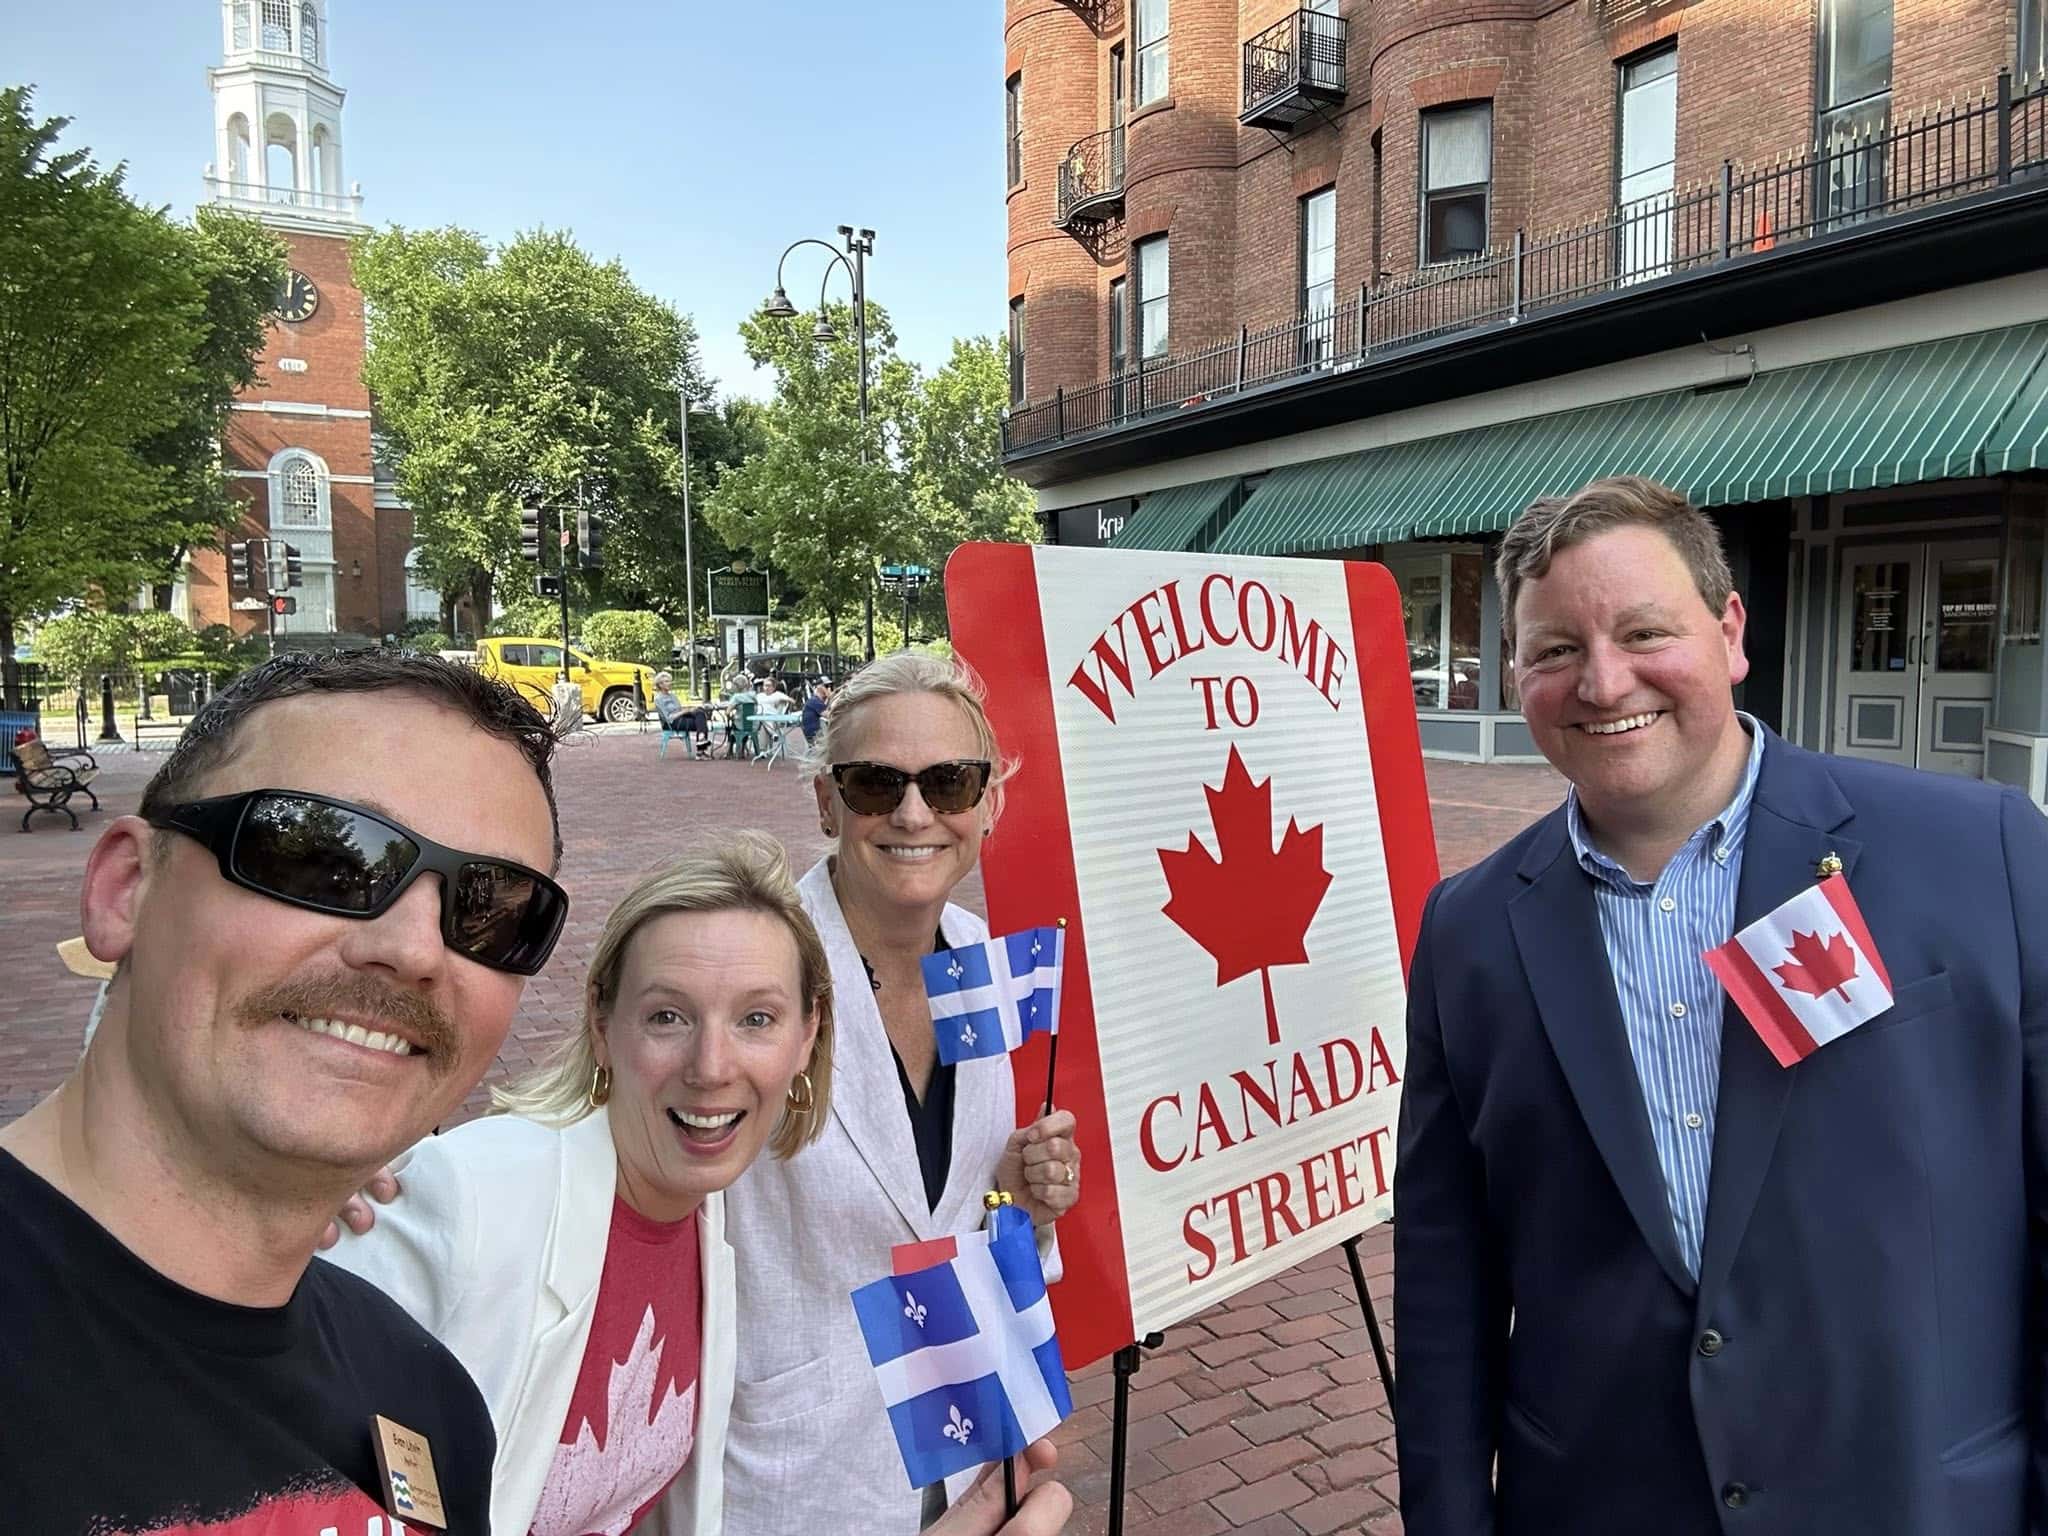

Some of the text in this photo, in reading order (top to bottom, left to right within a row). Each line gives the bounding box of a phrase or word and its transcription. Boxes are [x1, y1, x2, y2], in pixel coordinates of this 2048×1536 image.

[1067, 573, 1347, 725] WELCOME
[1190, 676, 1259, 730] TO
[1140, 1026, 1401, 1172] CANADA
[1183, 1126, 1391, 1284] STREET
